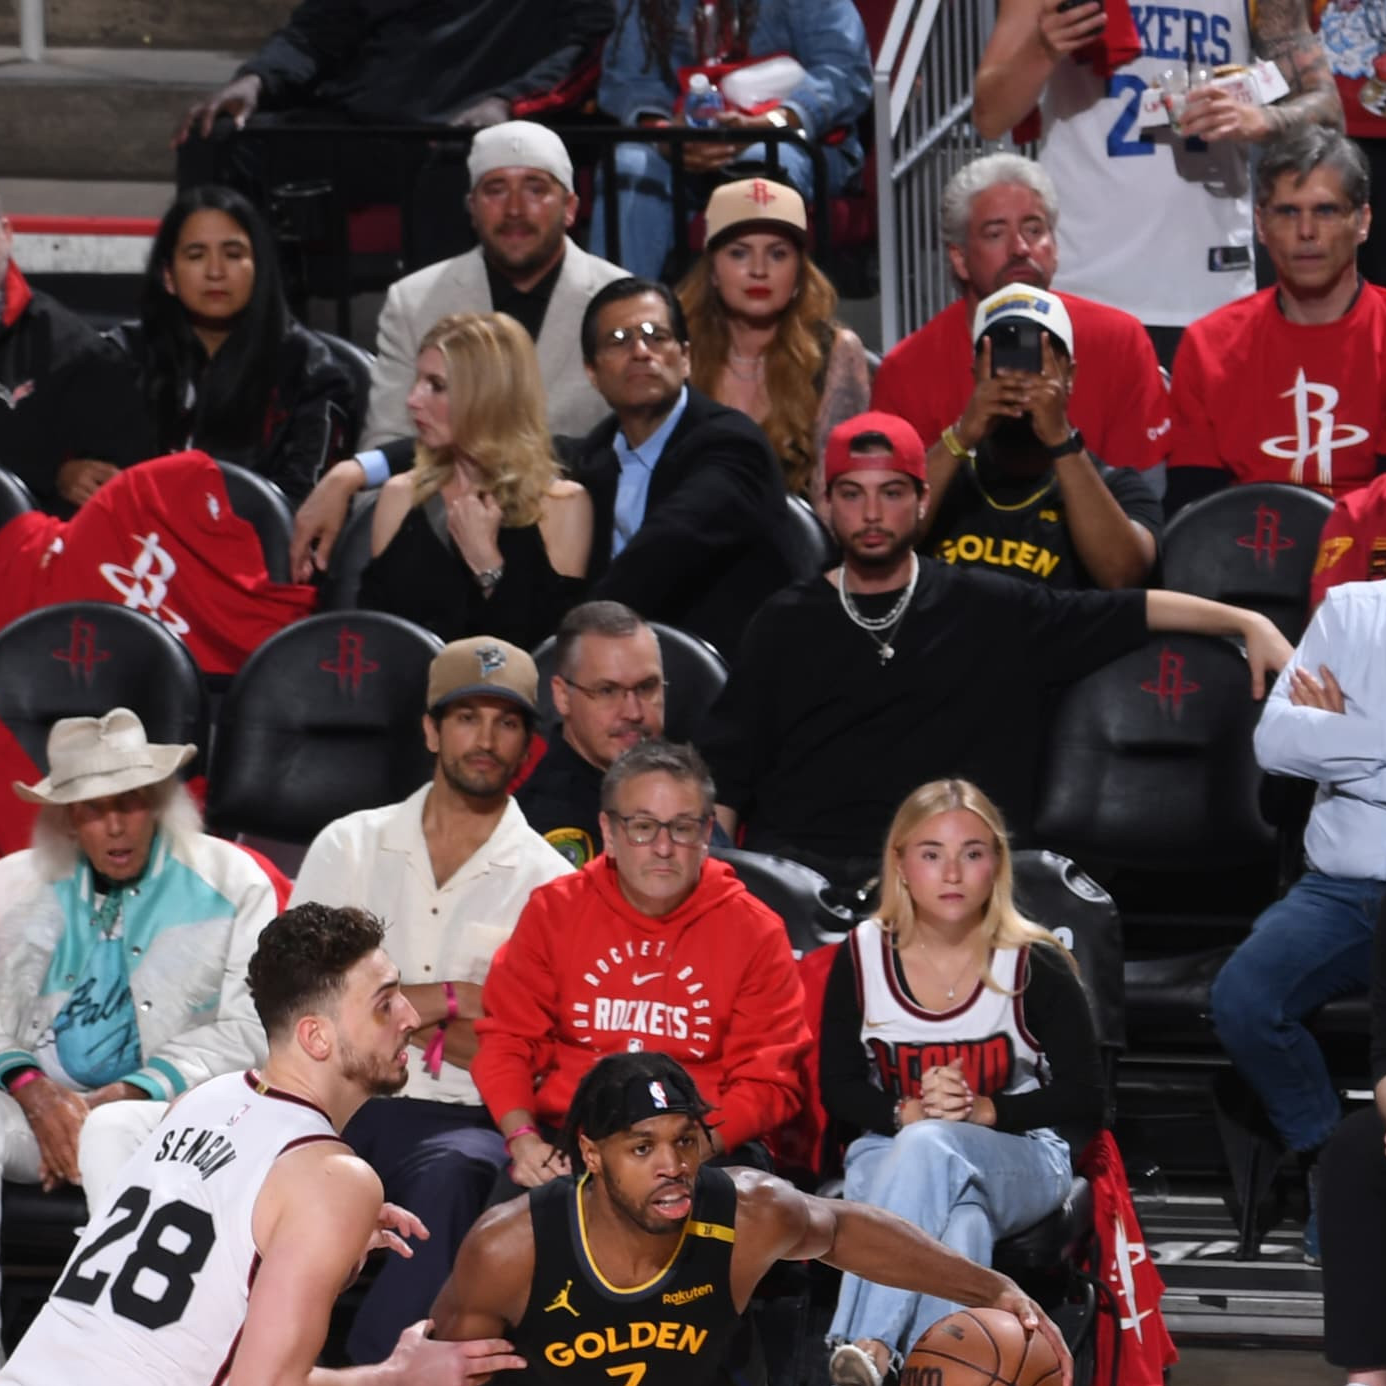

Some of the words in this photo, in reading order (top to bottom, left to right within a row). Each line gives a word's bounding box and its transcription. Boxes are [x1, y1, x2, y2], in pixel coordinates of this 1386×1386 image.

[1130, 4, 1232, 66] KERS
[594, 997, 689, 1040] ROCKETS
[52, 1185, 217, 1331] 28
[662, 1283, 714, 1306] Rakuten
[544, 1320, 709, 1368] GOLDEN
